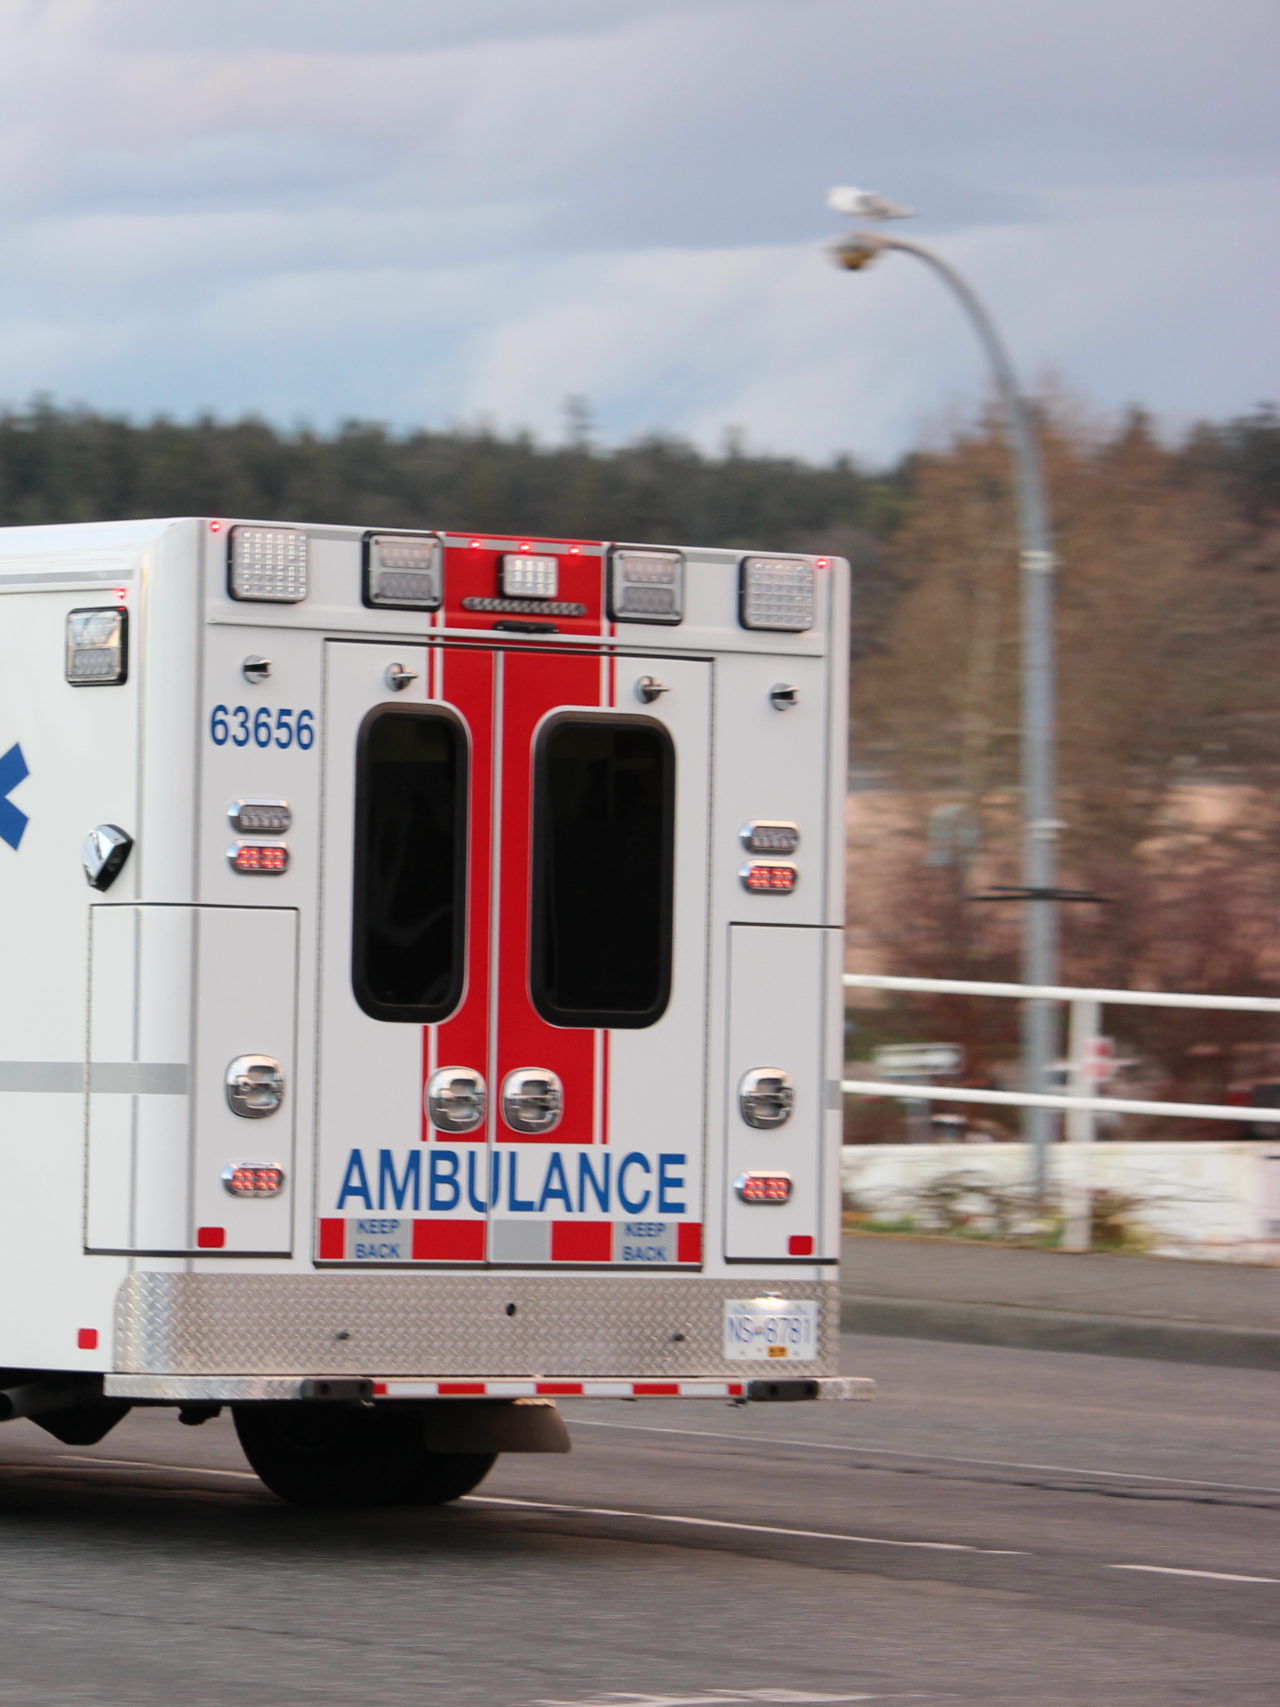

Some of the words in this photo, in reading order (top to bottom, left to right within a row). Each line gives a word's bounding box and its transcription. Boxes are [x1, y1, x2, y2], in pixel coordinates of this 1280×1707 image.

[211, 704, 314, 750] 63656
[335, 1148, 687, 1215] AMBULANCE
[357, 1218, 401, 1234] KEEP
[624, 1222, 667, 1237] KEEP
[355, 1243, 401, 1259] BACK
[622, 1246, 668, 1262] BACK
